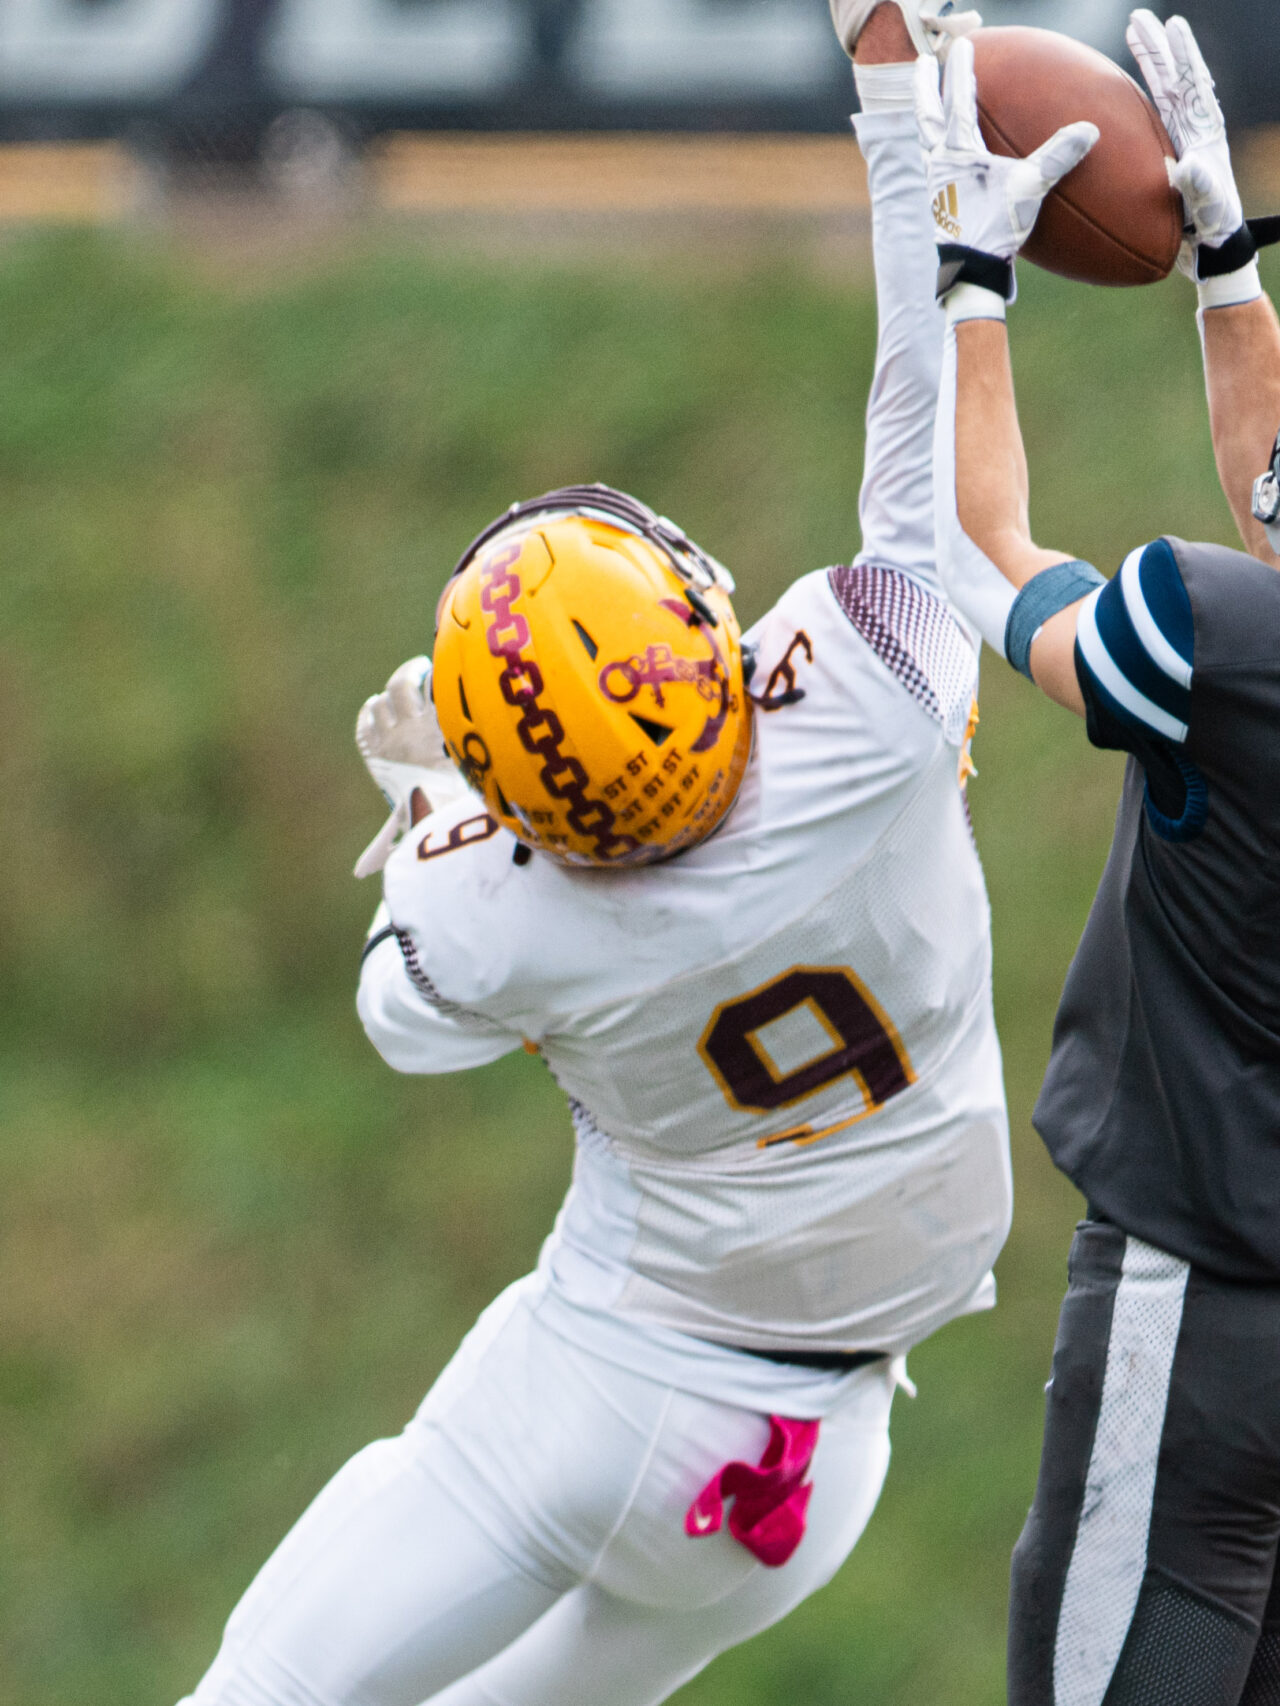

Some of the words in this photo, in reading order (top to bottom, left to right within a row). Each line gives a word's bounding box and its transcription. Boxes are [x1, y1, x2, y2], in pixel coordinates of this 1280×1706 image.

[604, 775, 628, 799] ST
[626, 750, 648, 777] ST
[643, 773, 665, 799] ST
[662, 747, 683, 775] ST
[696, 963, 918, 1149] 9
